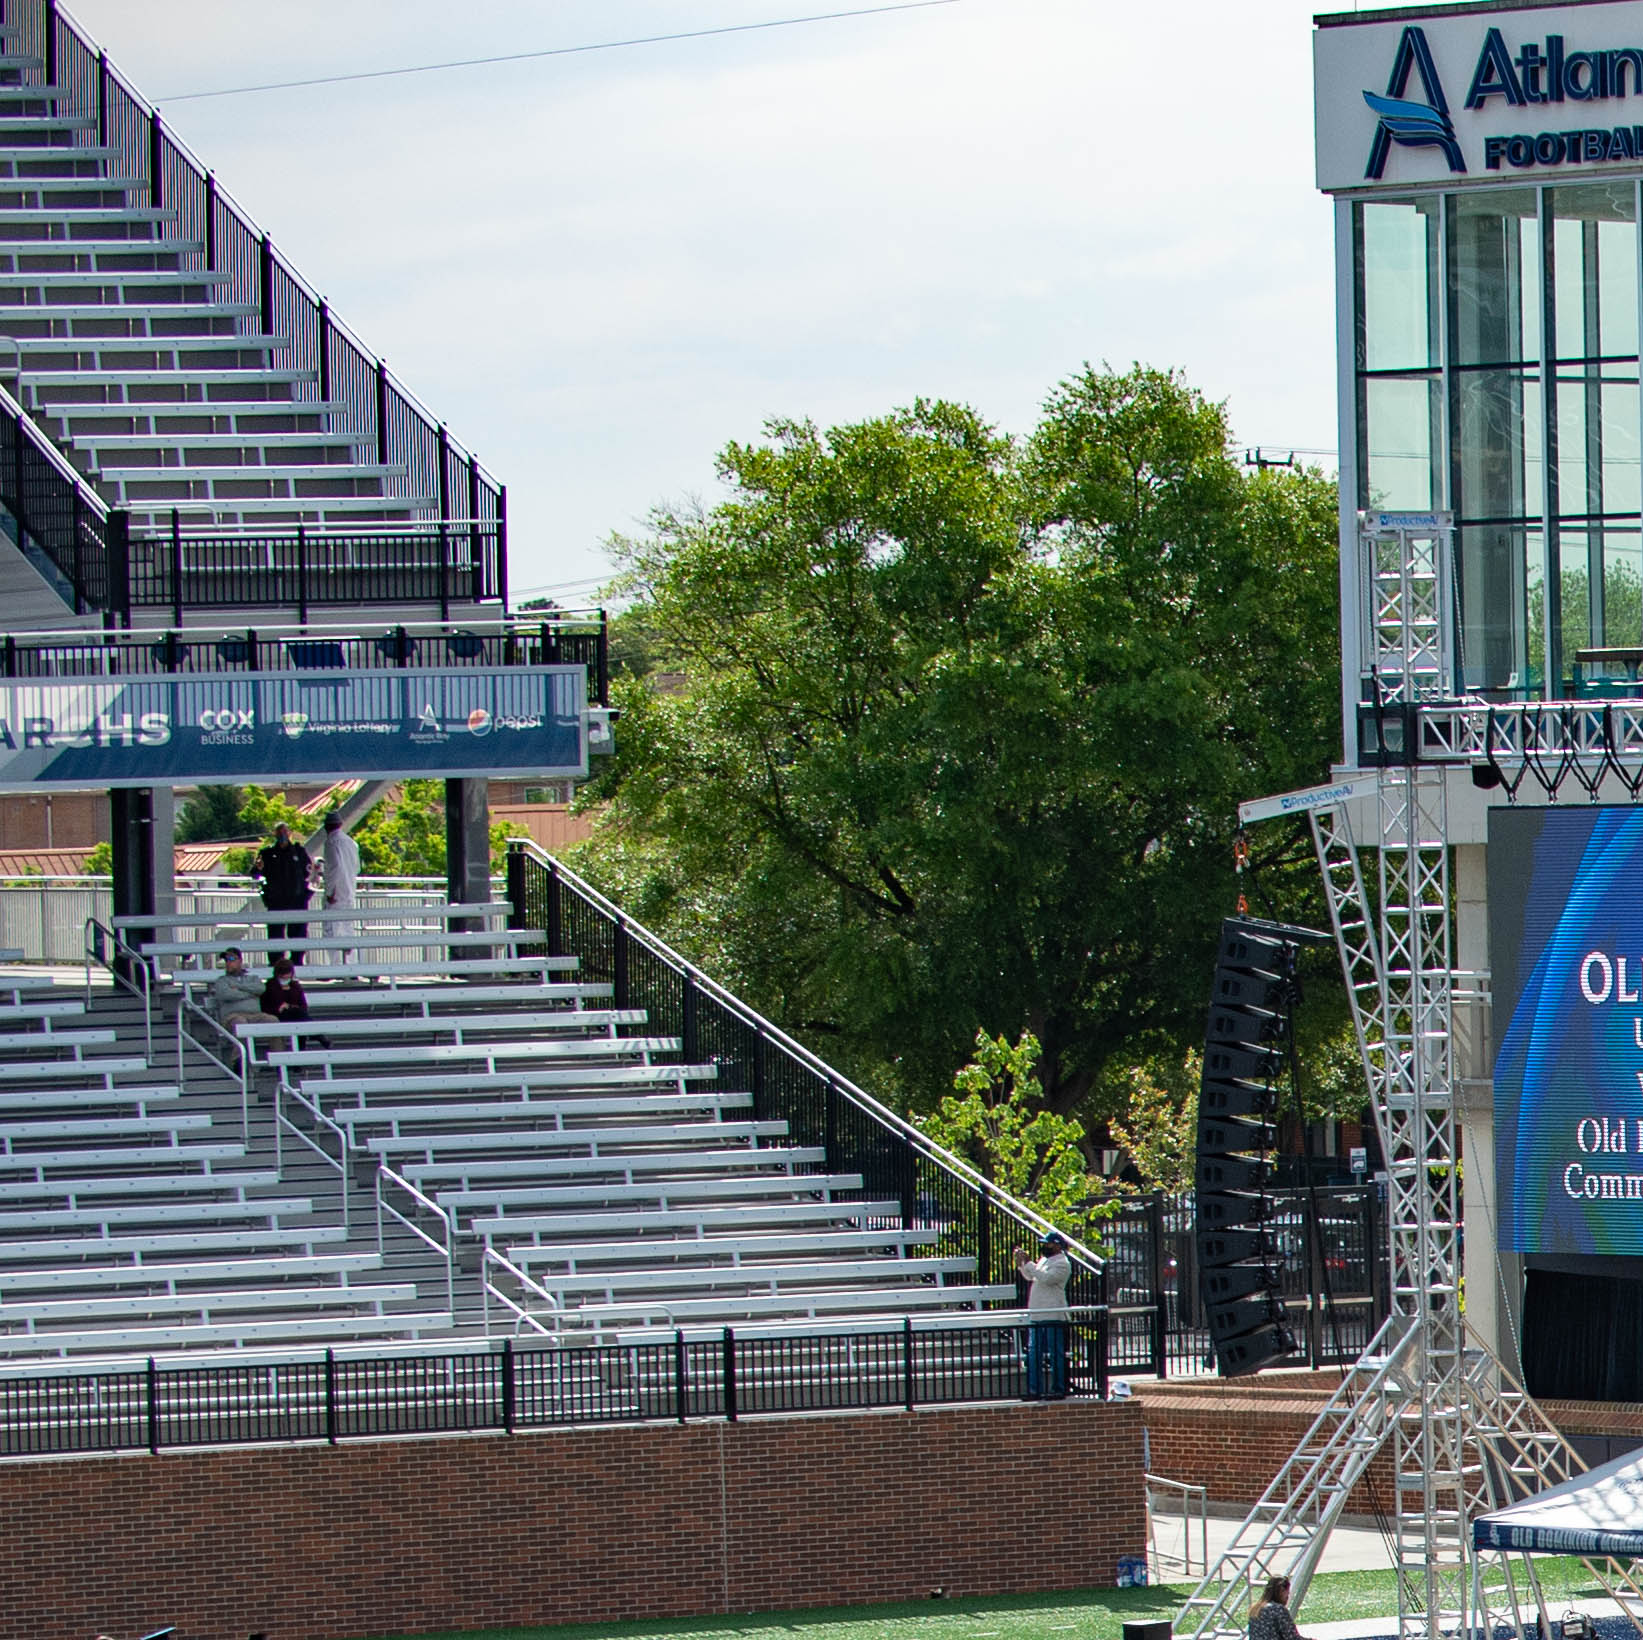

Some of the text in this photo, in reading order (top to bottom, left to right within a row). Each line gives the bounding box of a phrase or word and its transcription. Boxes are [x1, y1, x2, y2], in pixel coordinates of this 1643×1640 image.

[200, 709, 254, 730] COX
[494, 712, 543, 733] pepsi
[201, 734, 254, 746] BUSINESS
[1577, 1118, 1627, 1155] Old
[1511, 1527, 1533, 1548] OLD
